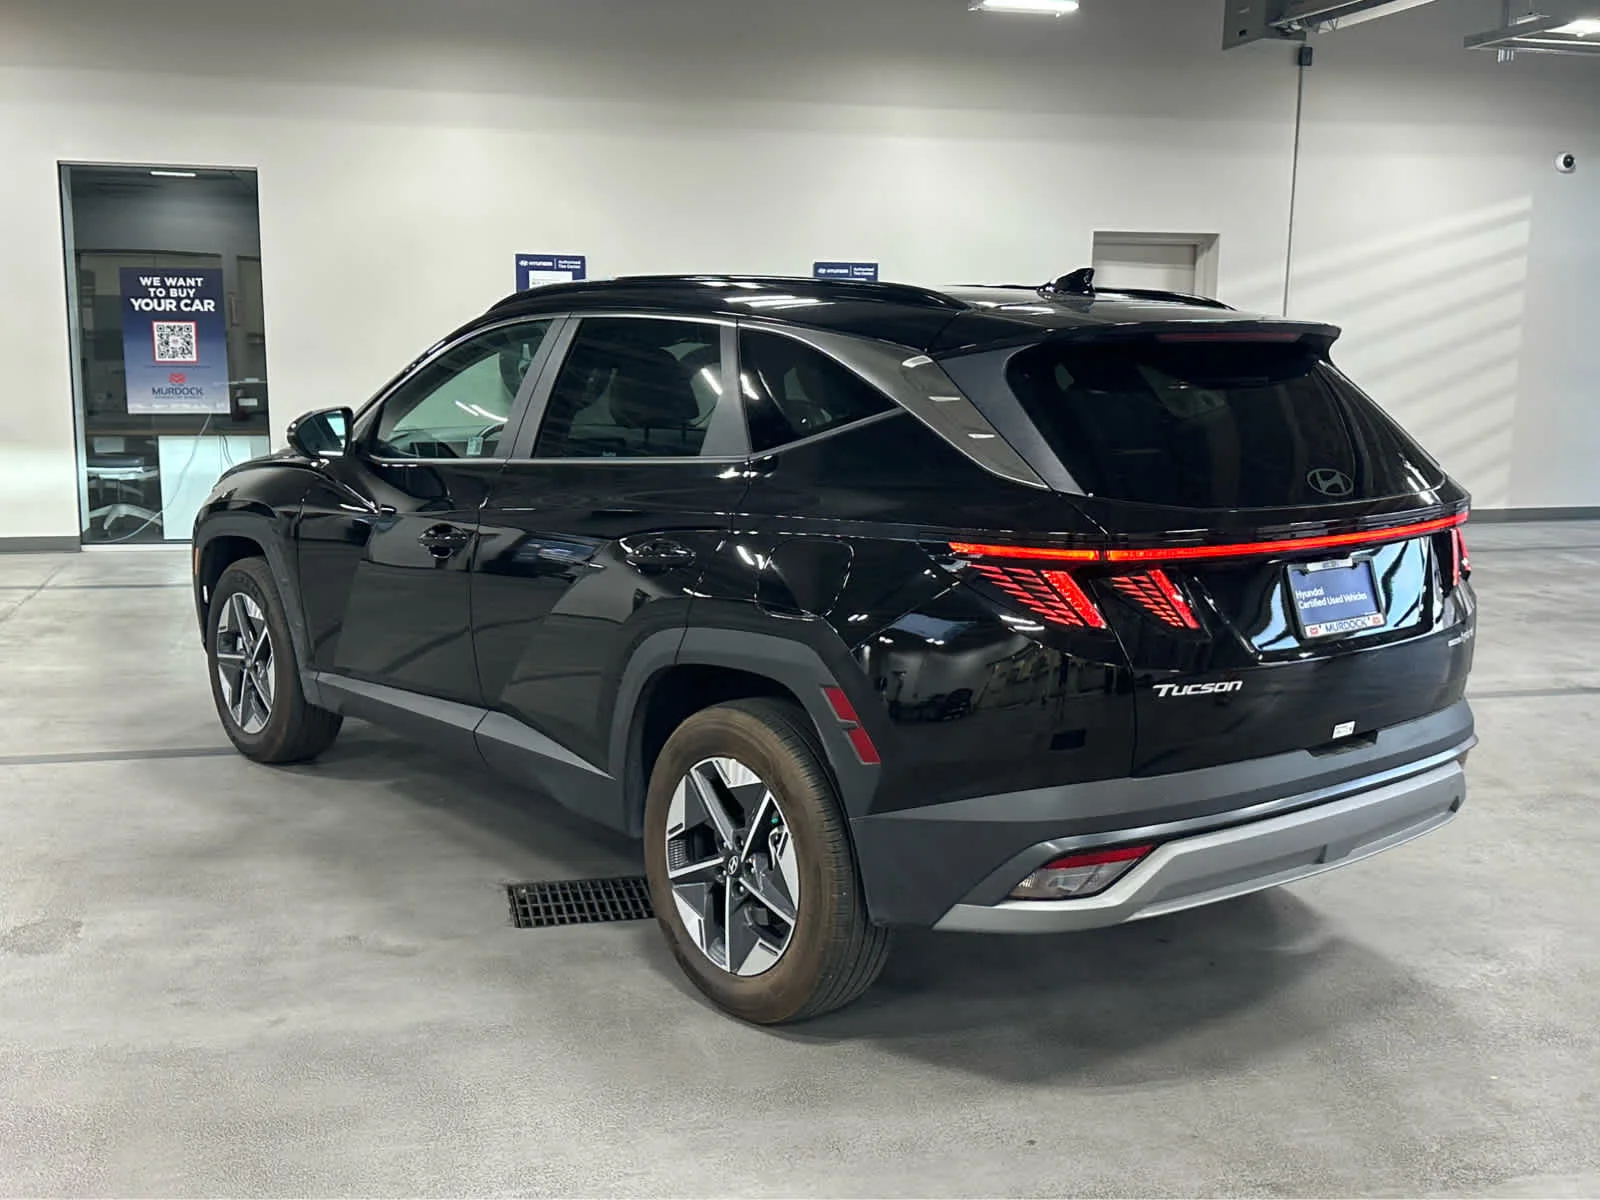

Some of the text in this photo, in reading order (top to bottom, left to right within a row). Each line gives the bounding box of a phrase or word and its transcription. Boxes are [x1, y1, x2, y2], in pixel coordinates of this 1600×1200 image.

[139, 276, 204, 287] WE WANT
[148, 288, 196, 297] TO BUY
[130, 298, 216, 312] YOUR CAR
[151, 386, 204, 397] MURDOCK
[1295, 587, 1324, 600] Hyundai
[1298, 592, 1367, 609] Certified Used Vehicles
[1325, 619, 1367, 632] MURDOCK
